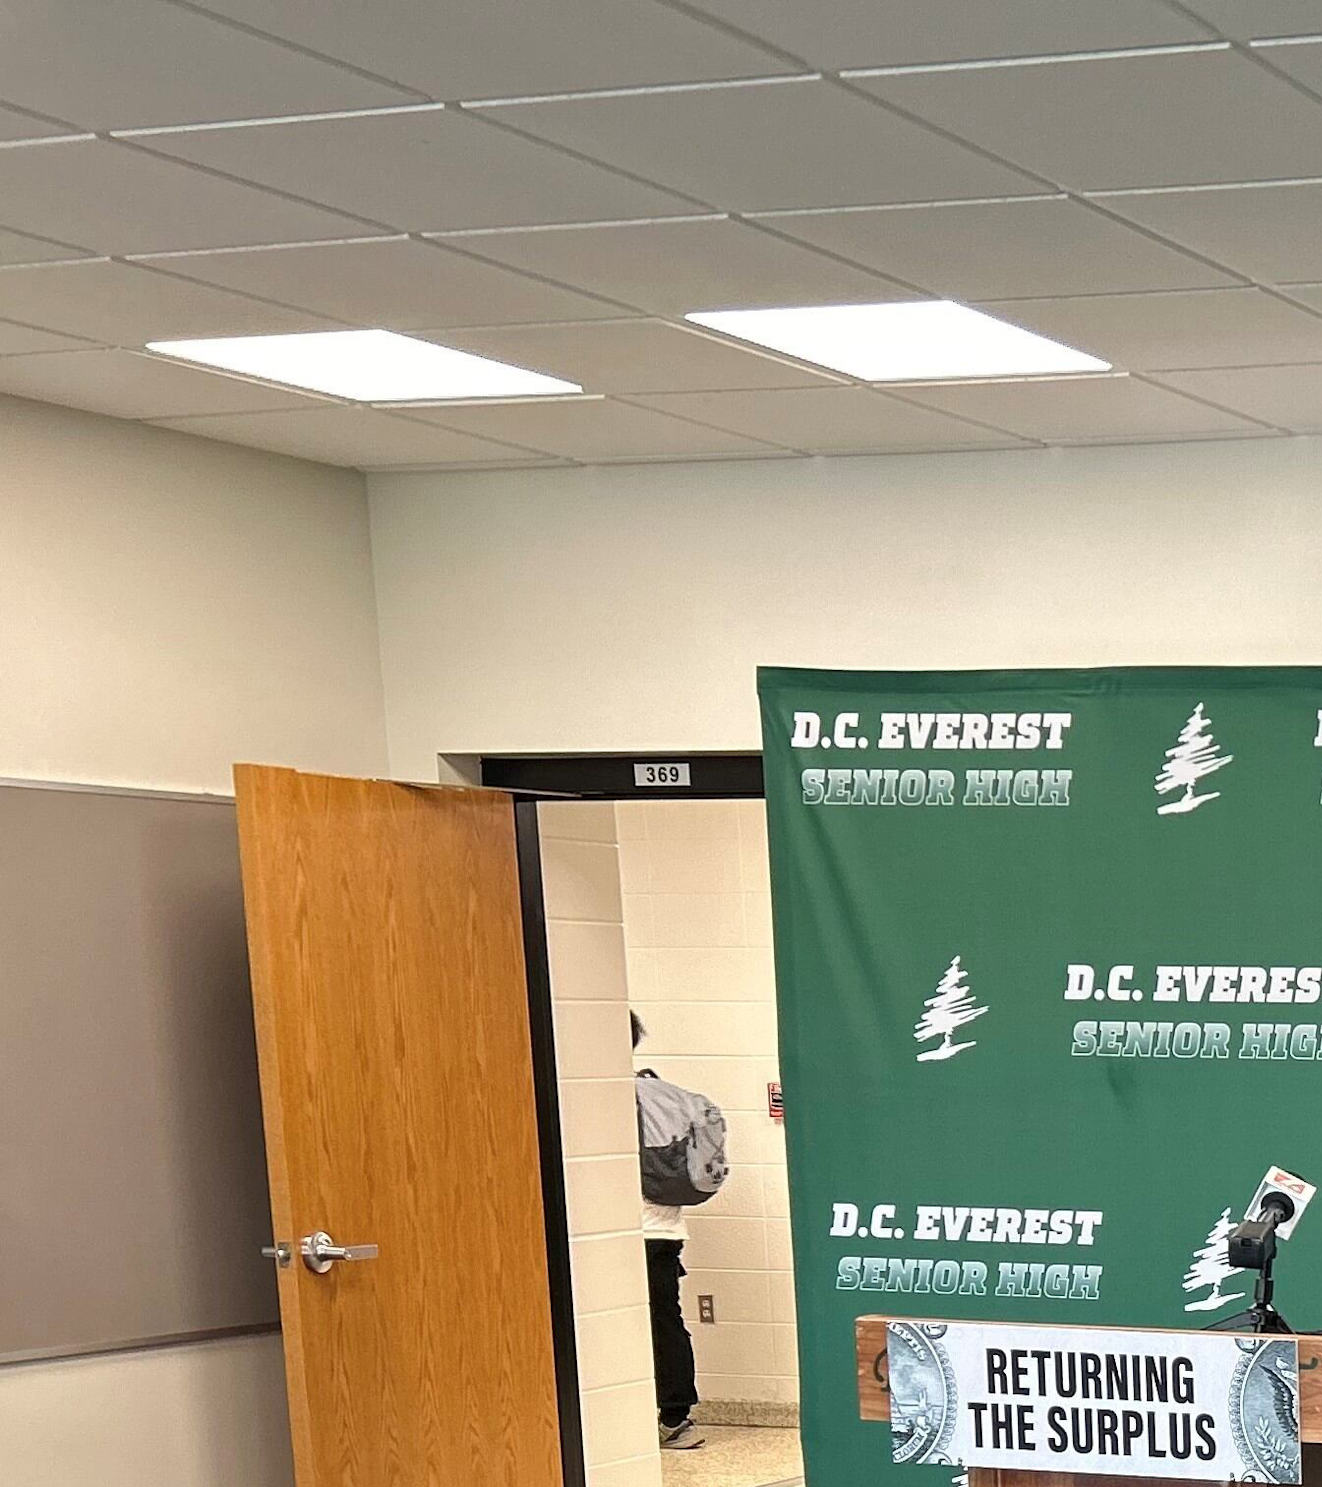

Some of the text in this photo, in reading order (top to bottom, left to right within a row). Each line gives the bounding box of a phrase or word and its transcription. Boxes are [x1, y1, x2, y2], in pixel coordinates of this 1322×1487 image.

[791, 712, 1072, 749] D.C. EVEREST
[646, 766, 679, 783] 369
[802, 769, 1072, 806] SENIOR HIGH
[1064, 965, 1143, 1001] D.C.
[1071, 1021, 1230, 1058] SENIOR
[830, 1203, 1103, 1245] D.C. EVEREST
[836, 1257, 1102, 1299] SENIOR HIGH
[986, 1349, 1194, 1405] RETURNING
[968, 1403, 1035, 1450] THE
[1048, 1407, 1215, 1460] SURPLUS
